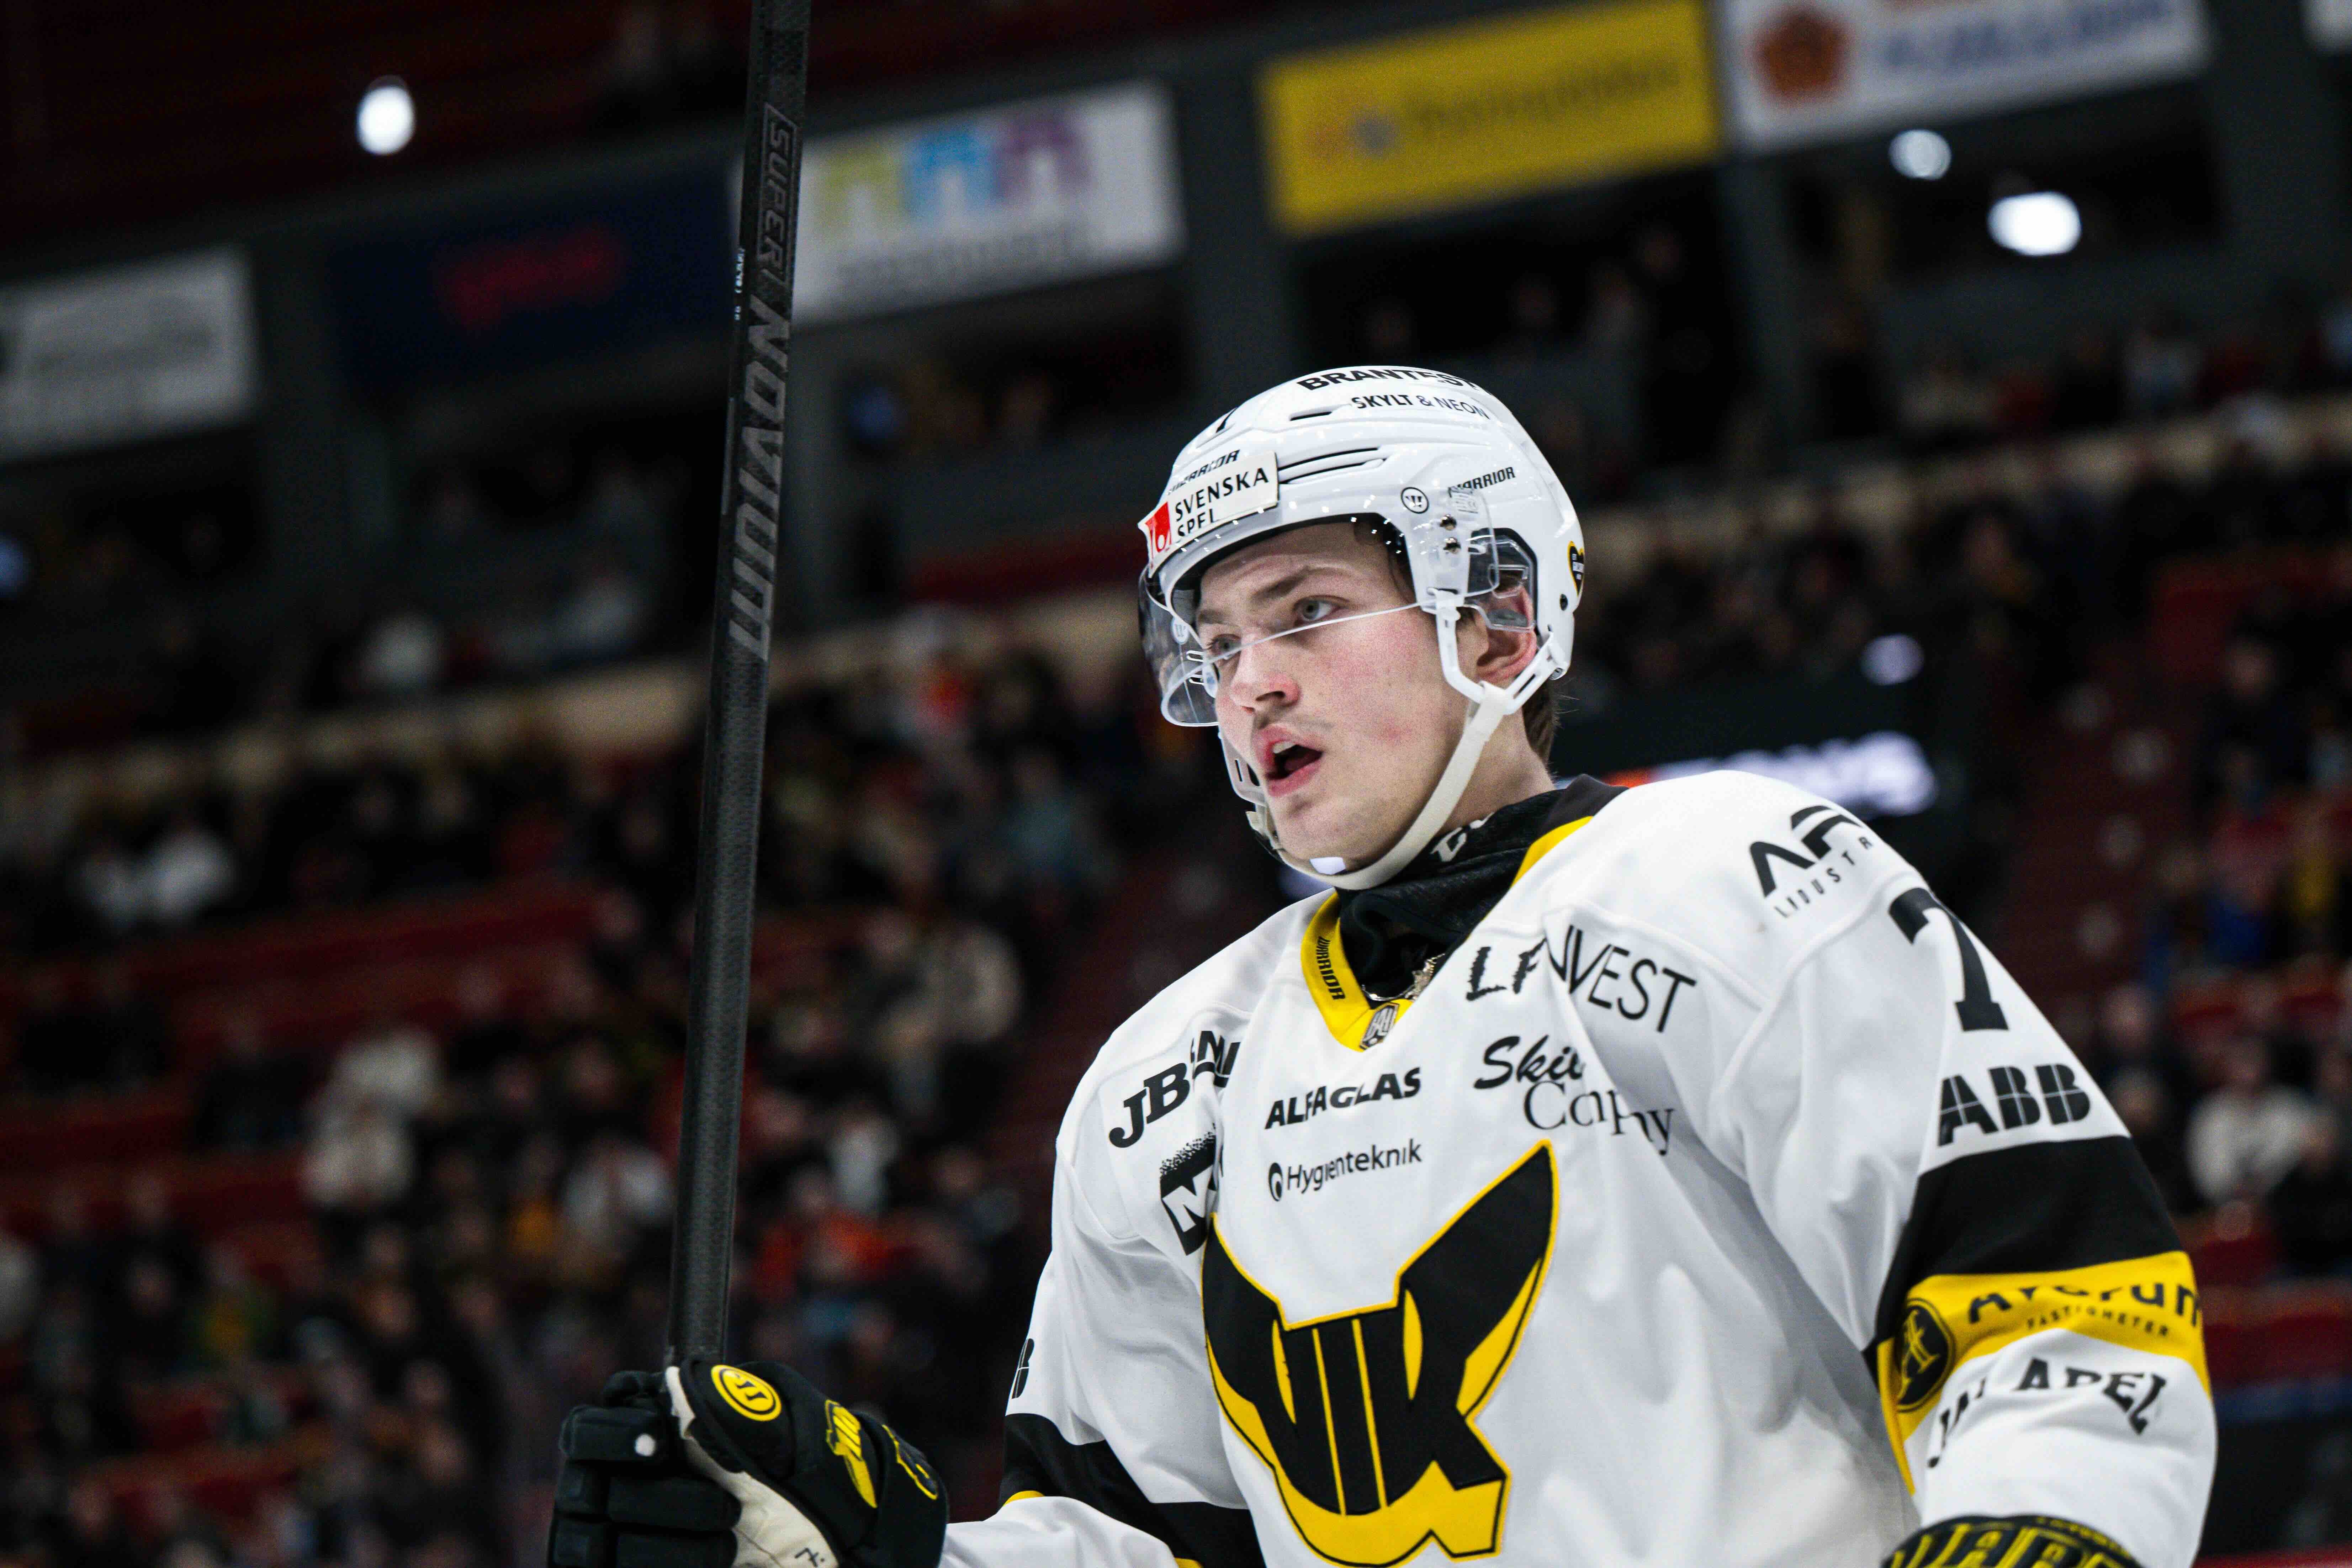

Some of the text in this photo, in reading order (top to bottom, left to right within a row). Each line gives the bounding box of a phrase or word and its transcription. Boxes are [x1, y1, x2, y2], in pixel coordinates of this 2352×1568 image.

[760, 122, 790, 267] SUPER
[1351, 394, 1491, 420] SKYLT & NEON
[1175, 467, 1269, 522] SVENSKA
[1316, 936, 1346, 1000] WARRIOR
[1888, 887, 2009, 1032] 7
[1264, 1066, 1422, 1130] ALFAGLAS
[1938, 1064, 2091, 1147] ABB
[1287, 1138, 1422, 1194] Hygienteknik
